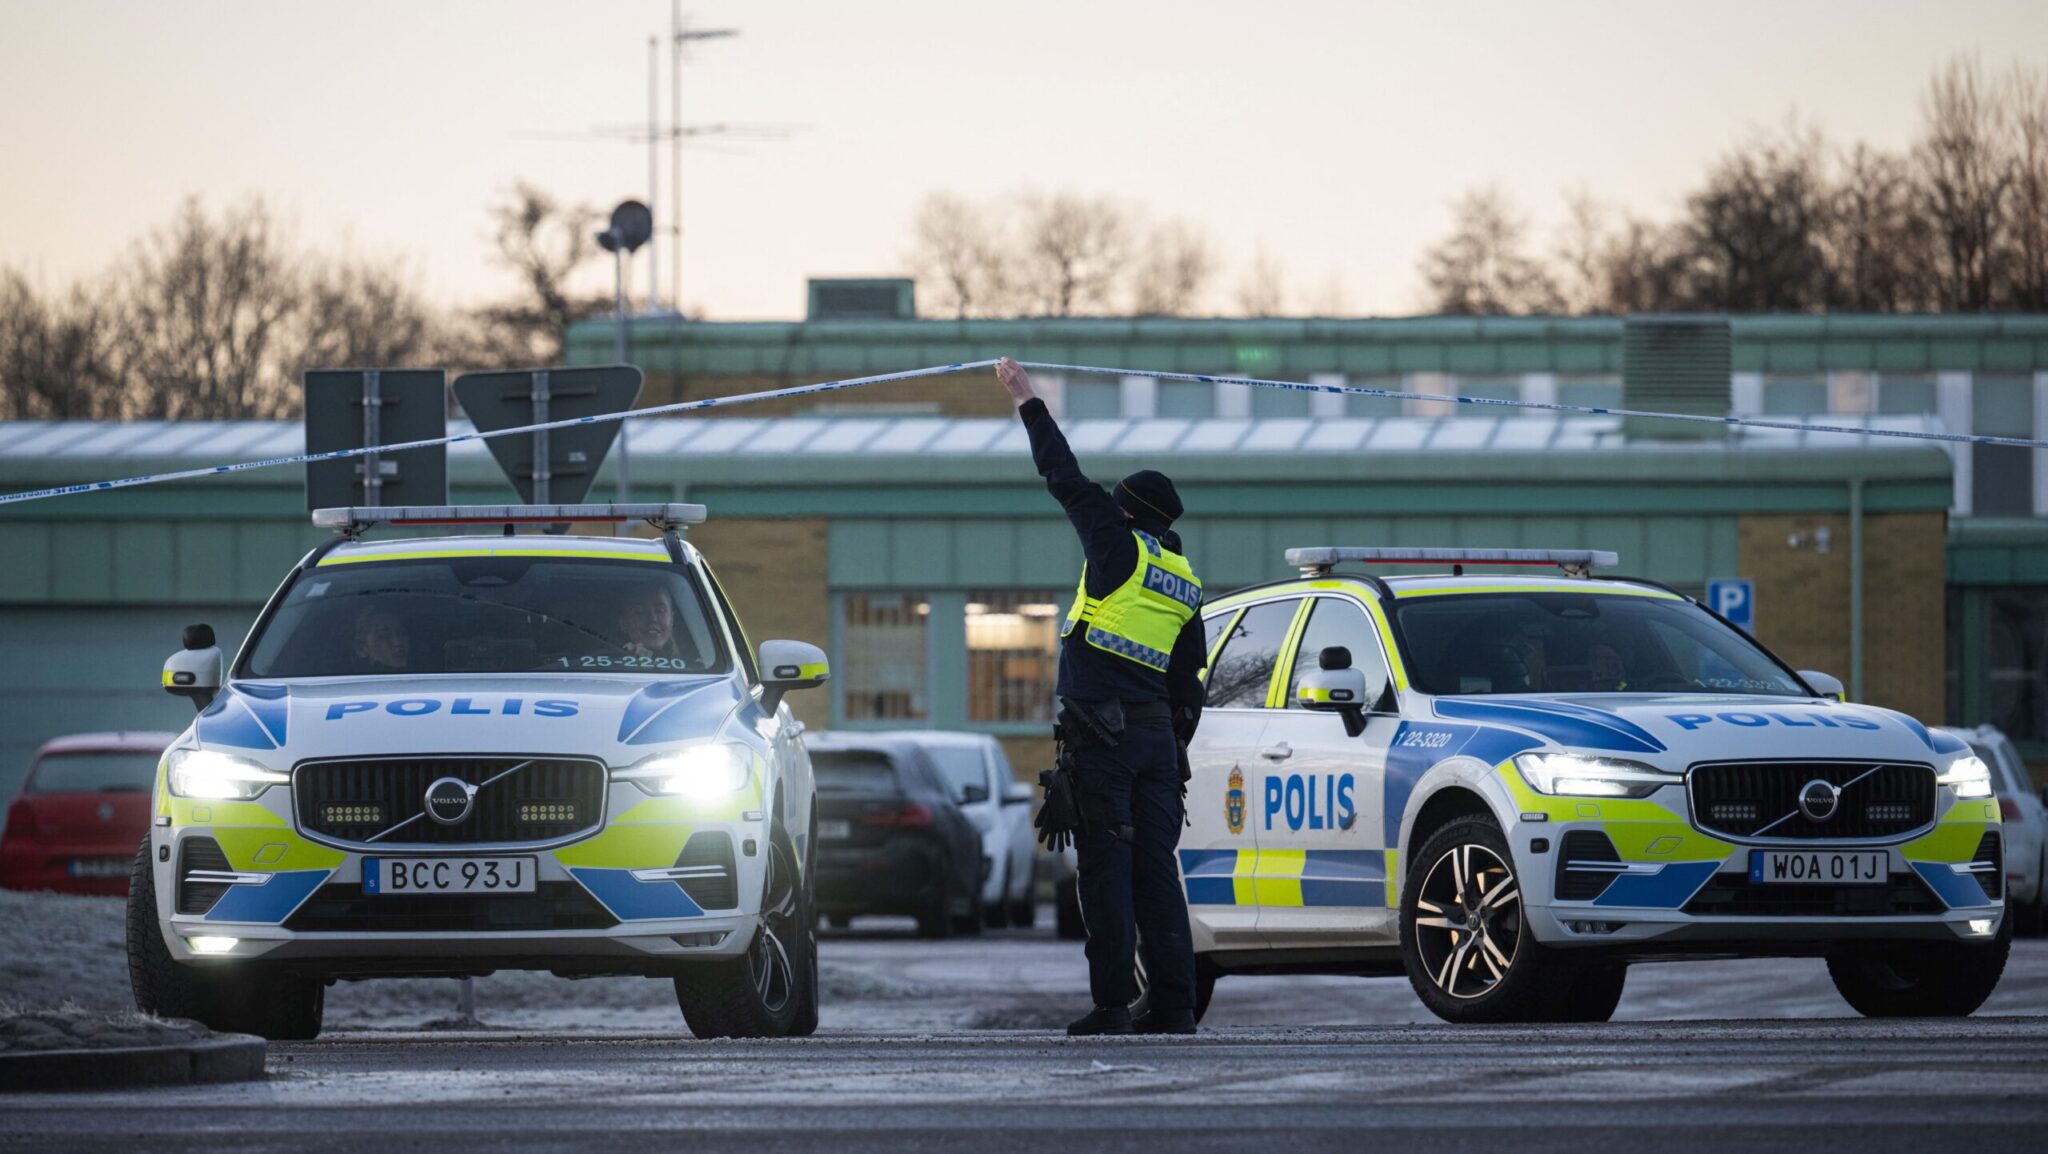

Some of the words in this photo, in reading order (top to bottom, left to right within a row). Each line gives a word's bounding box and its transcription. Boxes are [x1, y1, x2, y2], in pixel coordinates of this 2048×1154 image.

[1148, 566, 1199, 608] POLIS
[1719, 587, 1745, 618] P
[557, 656, 570, 668] 1
[580, 655, 686, 670] 25-2220
[325, 698, 580, 721] POLIS
[1665, 712, 1881, 731] POLIS
[1395, 730, 1407, 746] 1
[1402, 730, 1453, 748] 22-3320
[431, 797, 467, 805] VOLVO
[1265, 772, 1356, 832] POLIS
[1806, 796, 1834, 804] VOLVO
[391, 861, 450, 889] BCC
[461, 861, 521, 889] 93J
[1773, 854, 1822, 880] WOA
[1831, 854, 1877, 880] 01J
